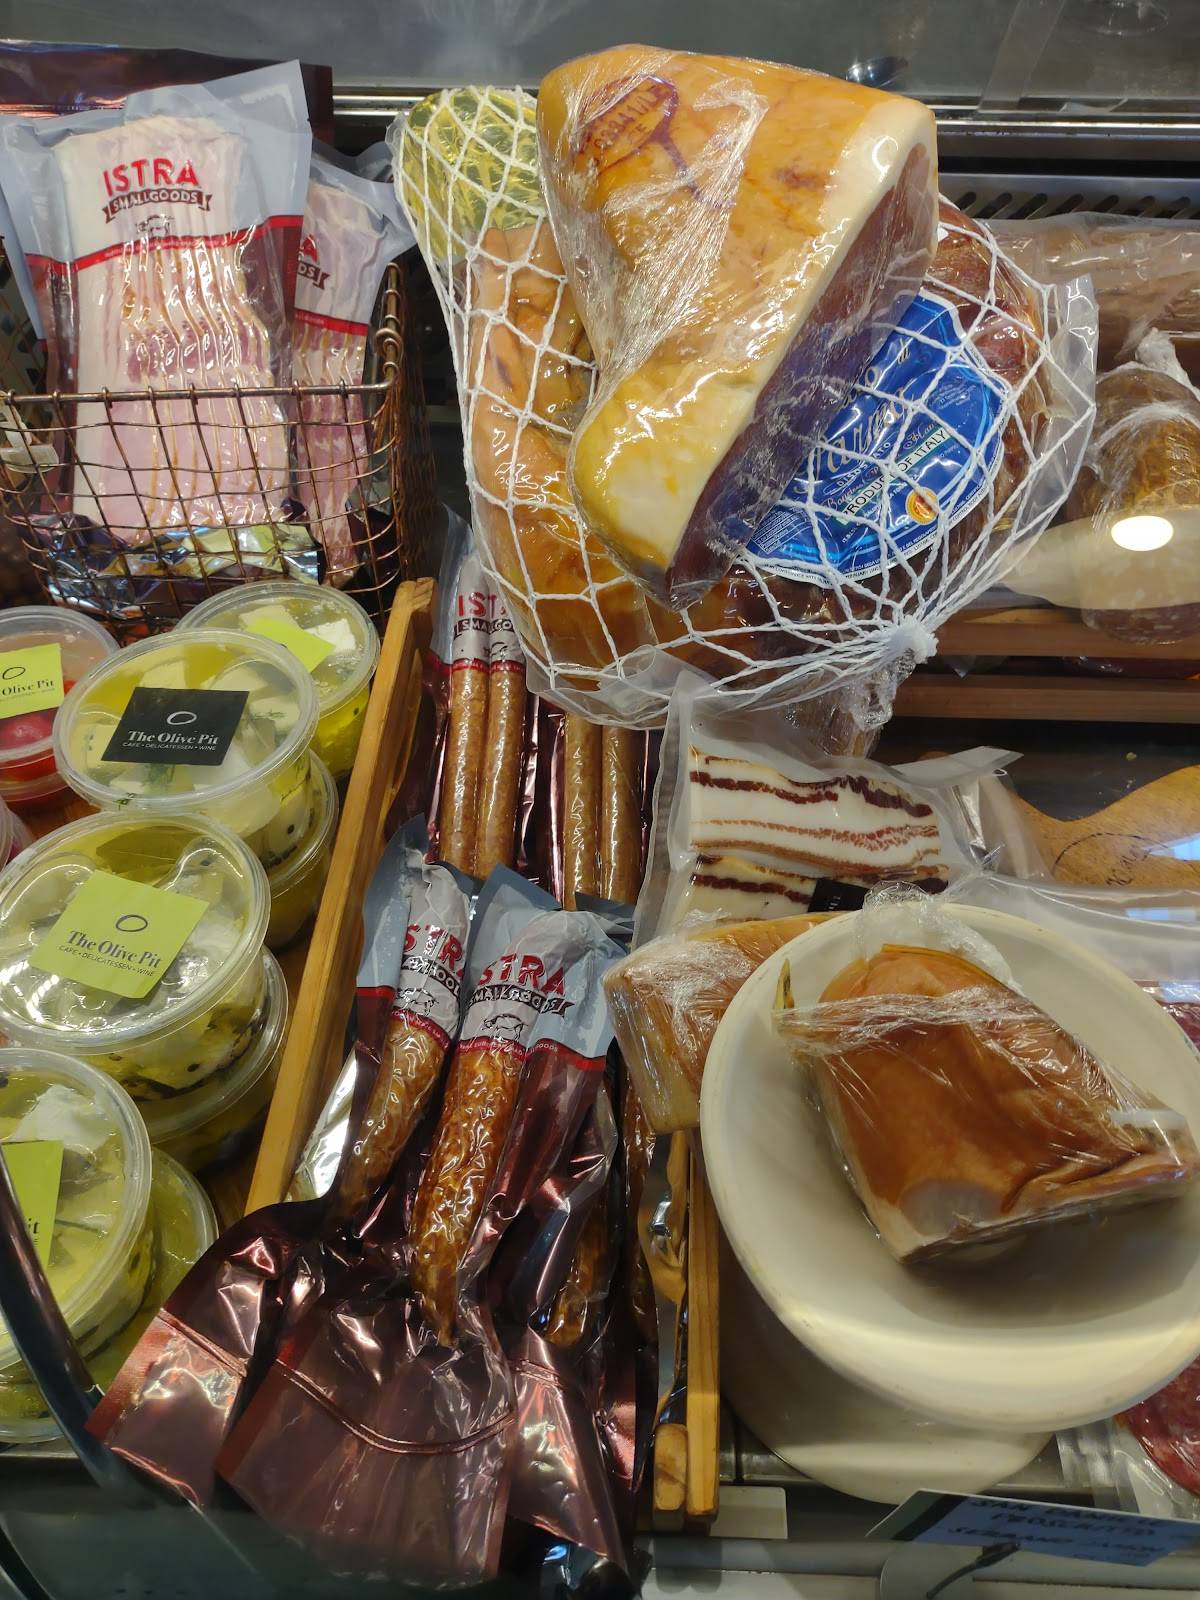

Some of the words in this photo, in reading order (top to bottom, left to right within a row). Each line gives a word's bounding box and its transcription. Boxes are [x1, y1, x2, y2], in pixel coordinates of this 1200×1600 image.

[103, 158, 200, 198] ISTRA
[112, 189, 198, 211] SMALLGOODS
[837, 441, 892, 488] DISOSATO
[842, 472, 896, 516] RODU
[897, 456, 914, 473] OF
[914, 429, 948, 458] ITALY
[458, 591, 507, 619] IST
[2, 685, 32, 696] Olive
[37, 679, 54, 689] Pit
[128, 730, 156, 742] The
[157, 731, 197, 744] Olive
[197, 734, 219, 745] Pit
[145, 742, 194, 750] DELICATESSEN
[58, 944, 78, 956] CAFE
[81, 952, 132, 971] DELICATESSEN
[137, 967, 155, 977] WINE
[66, 930, 97, 950] The
[98, 940, 138, 962] Olive
[138, 951, 162, 969] Pit
